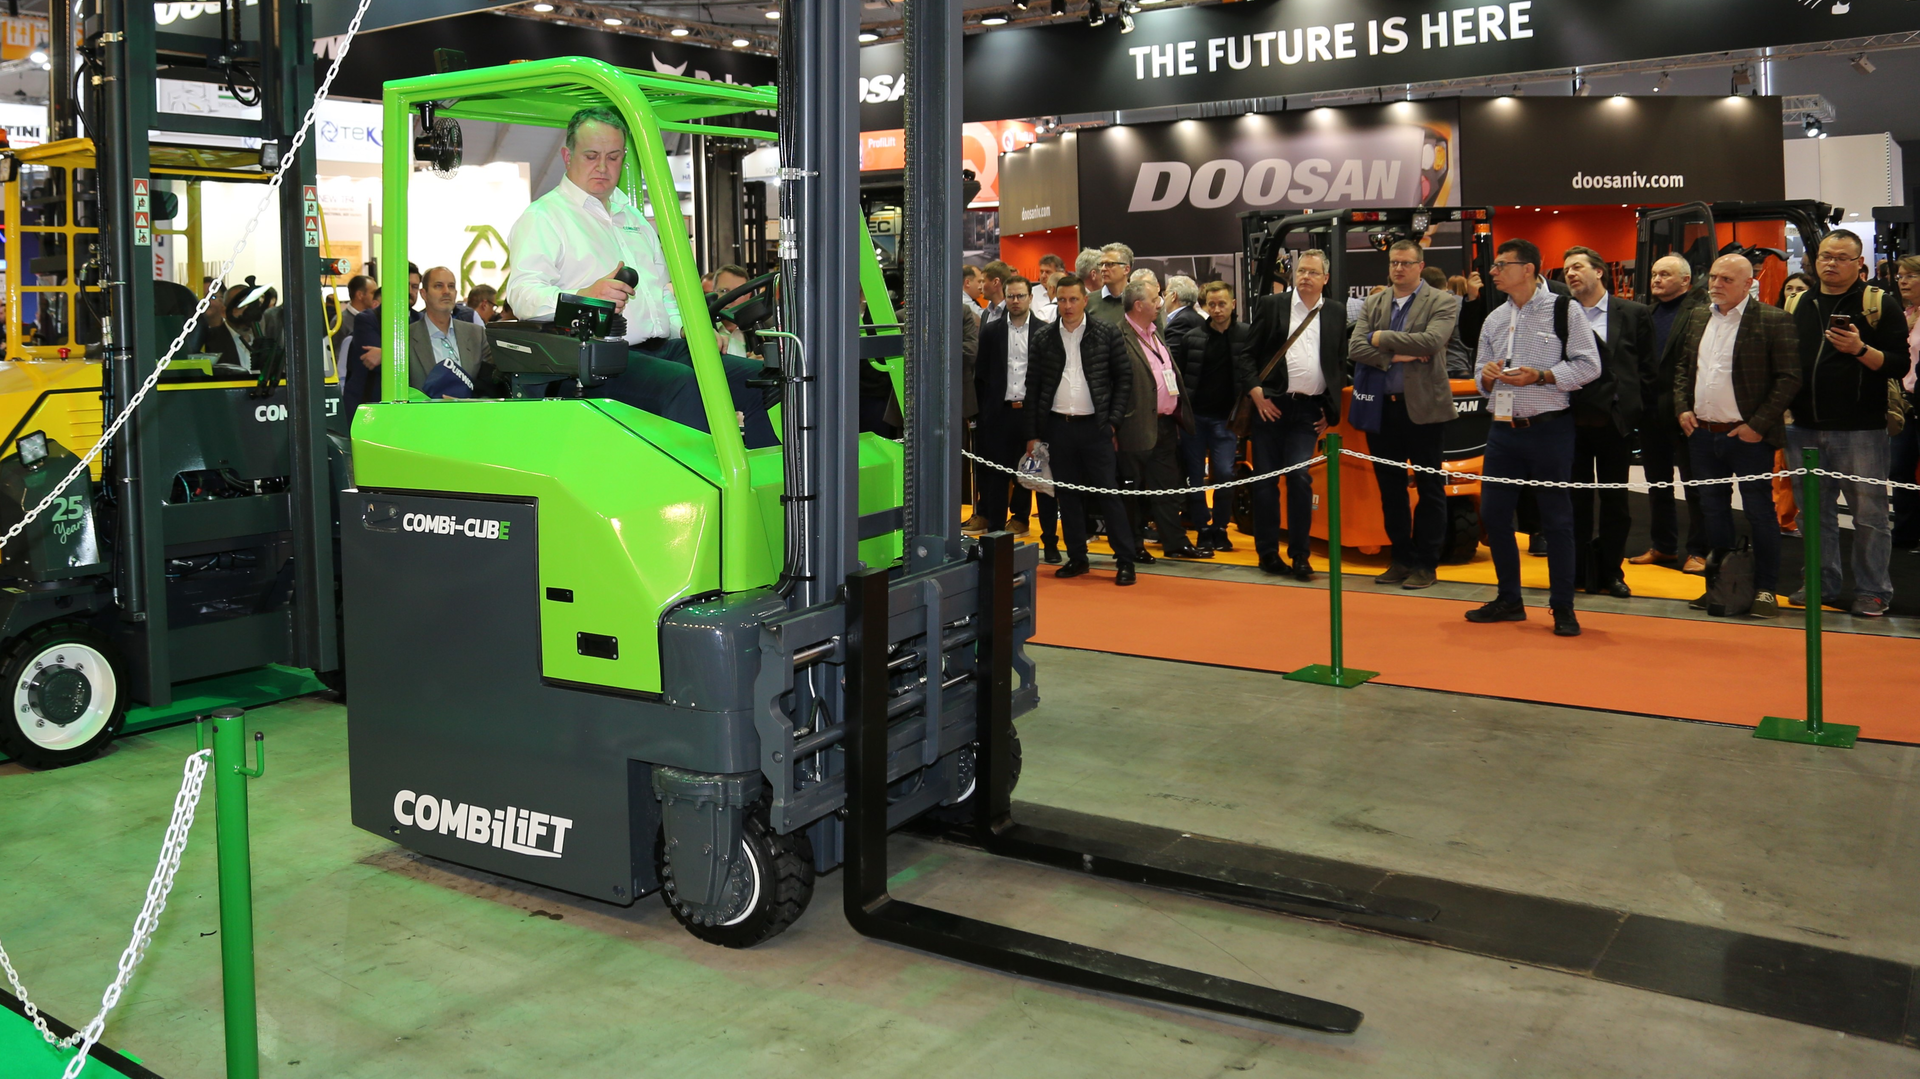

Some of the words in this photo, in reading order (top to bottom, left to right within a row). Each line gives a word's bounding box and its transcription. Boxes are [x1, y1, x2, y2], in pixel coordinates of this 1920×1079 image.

[1128, 40, 1198, 80] THE
[1208, 22, 1357, 72] FUTURE
[1368, 16, 1409, 55] IS
[1421, 1, 1534, 50] HERE
[868, 136, 896, 149] ProfiLift
[1128, 158, 1401, 213] DOOSAN
[1572, 171, 1684, 189] doosaniv.com
[52, 495, 84, 522] 25
